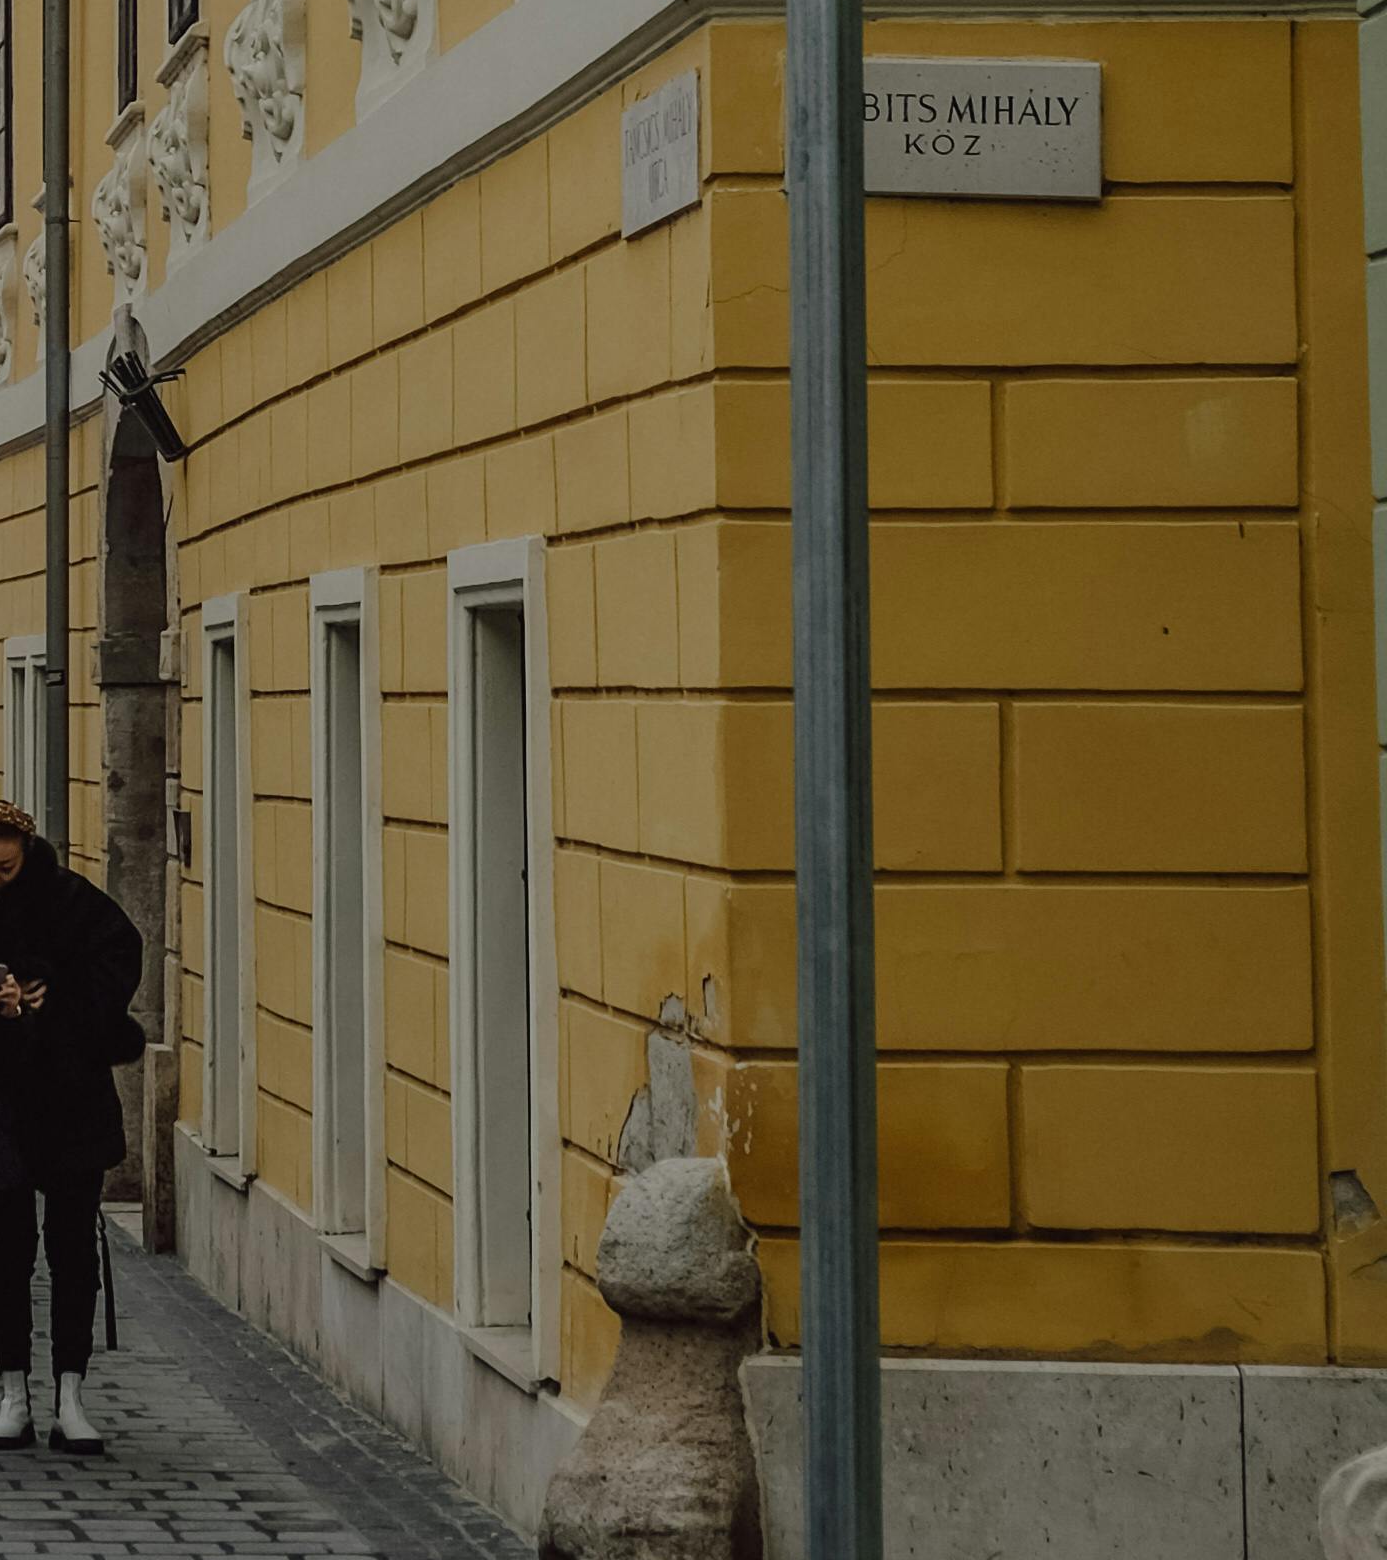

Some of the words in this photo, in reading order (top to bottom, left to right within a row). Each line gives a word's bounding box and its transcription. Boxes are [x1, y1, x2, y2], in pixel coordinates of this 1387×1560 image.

[862, 92, 938, 124] BITS
[946, 87, 1080, 127] MIHÁLY
[903, 128, 982, 156] KÖZ
